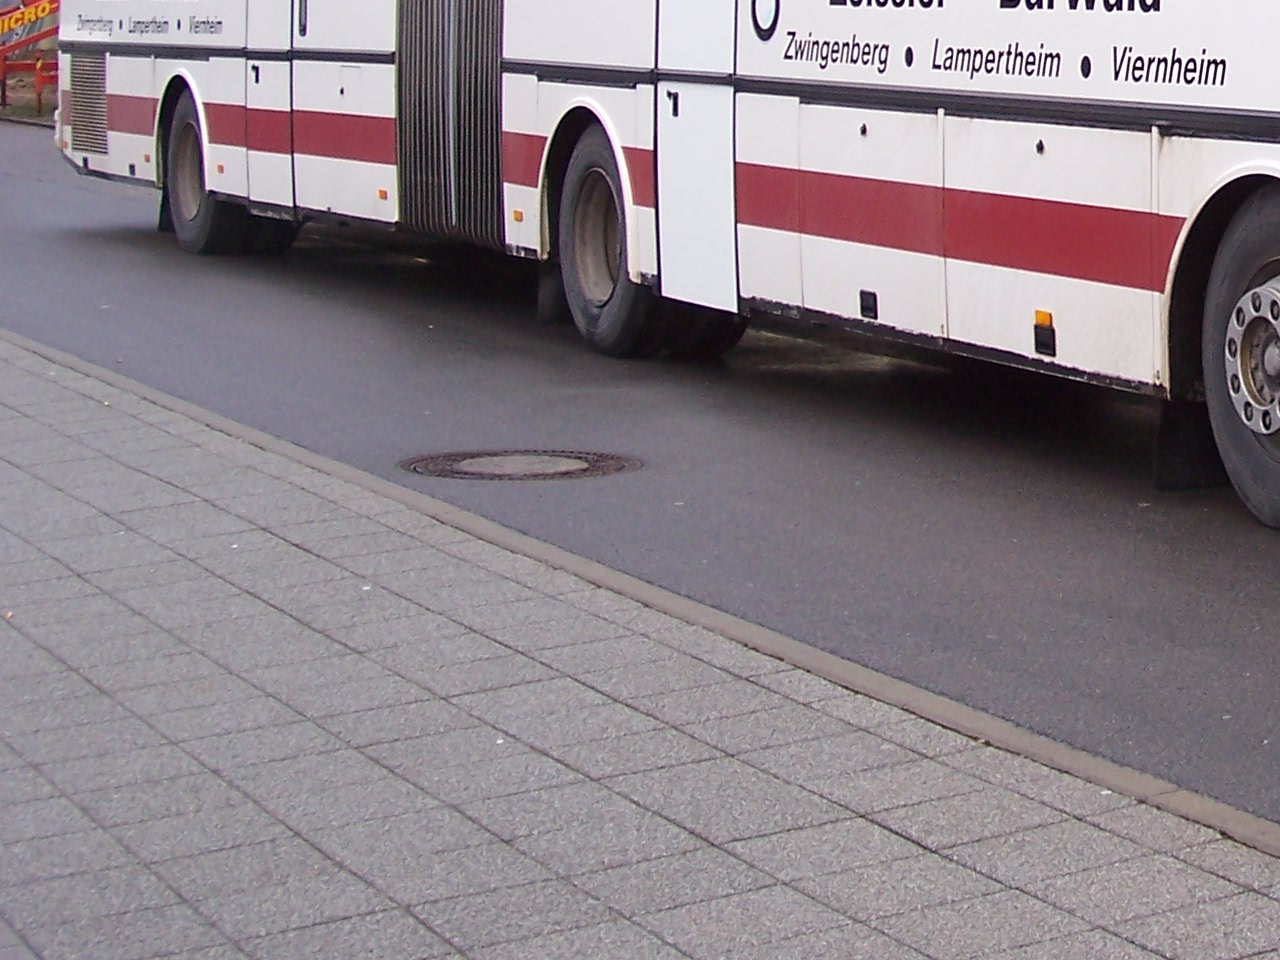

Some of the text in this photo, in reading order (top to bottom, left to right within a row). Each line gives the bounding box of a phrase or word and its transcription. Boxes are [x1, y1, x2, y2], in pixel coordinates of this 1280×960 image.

[783, 31, 1227, 86] Zwingenberg Lampertheim Viernheim
